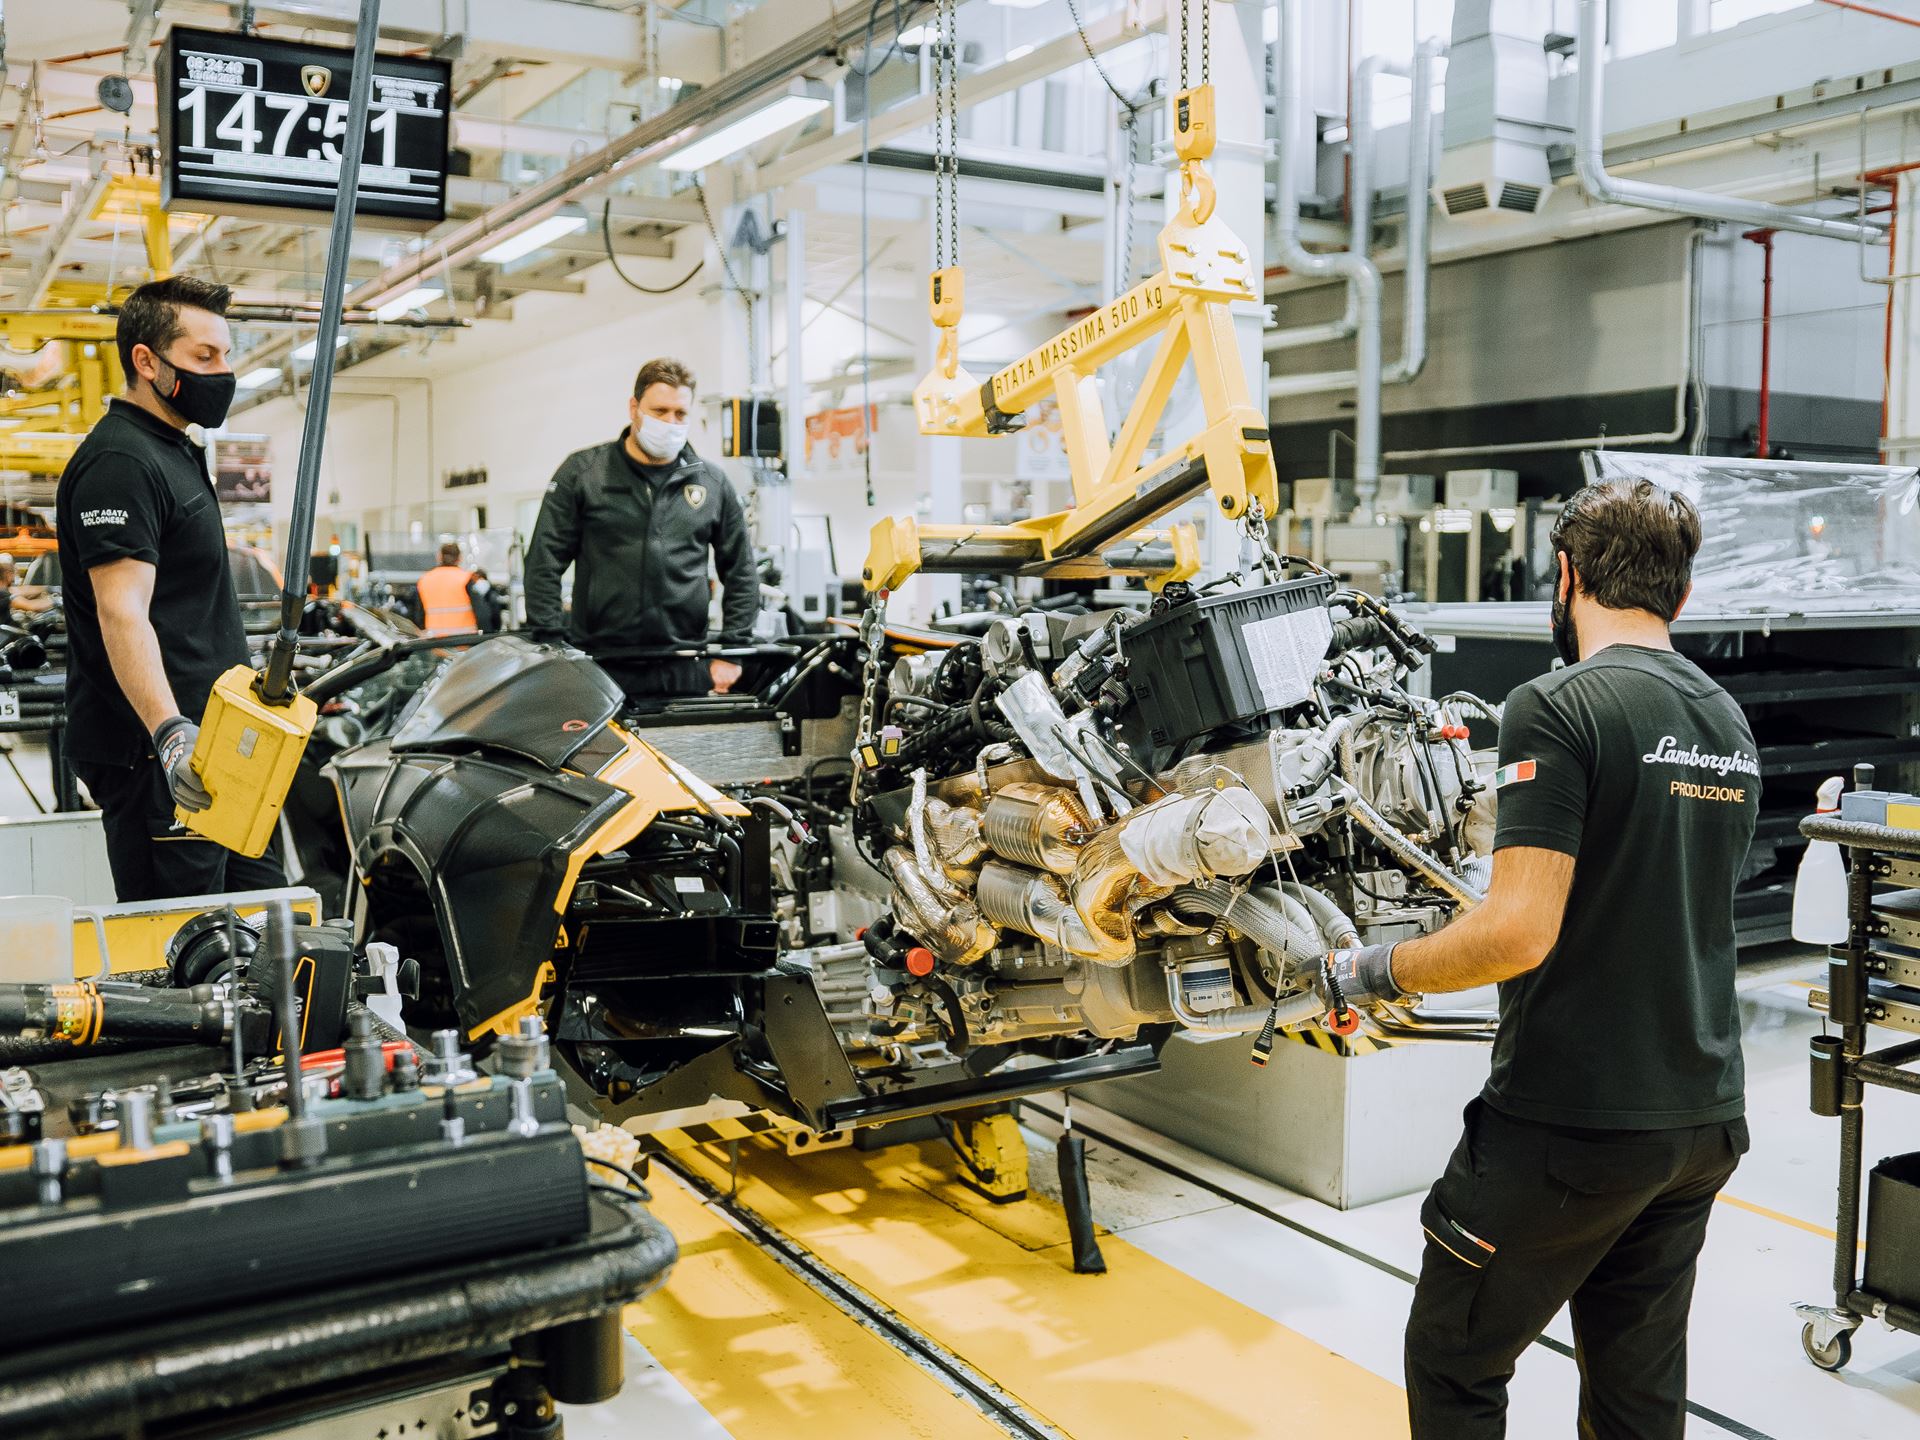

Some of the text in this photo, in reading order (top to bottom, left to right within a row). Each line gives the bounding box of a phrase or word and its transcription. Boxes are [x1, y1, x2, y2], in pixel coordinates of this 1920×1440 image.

[178, 86, 397, 167] 147:51
[1040, 316, 1106, 370] MASSIMA
[1111, 295, 1138, 328] 500
[1145, 286, 1163, 309] kg
[83, 516, 126, 527] BOLOGNESE
[100, 509, 129, 518] AGATA
[1642, 735, 1759, 777] Lamborghini
[1670, 780, 1746, 803] PRODUZIONE
